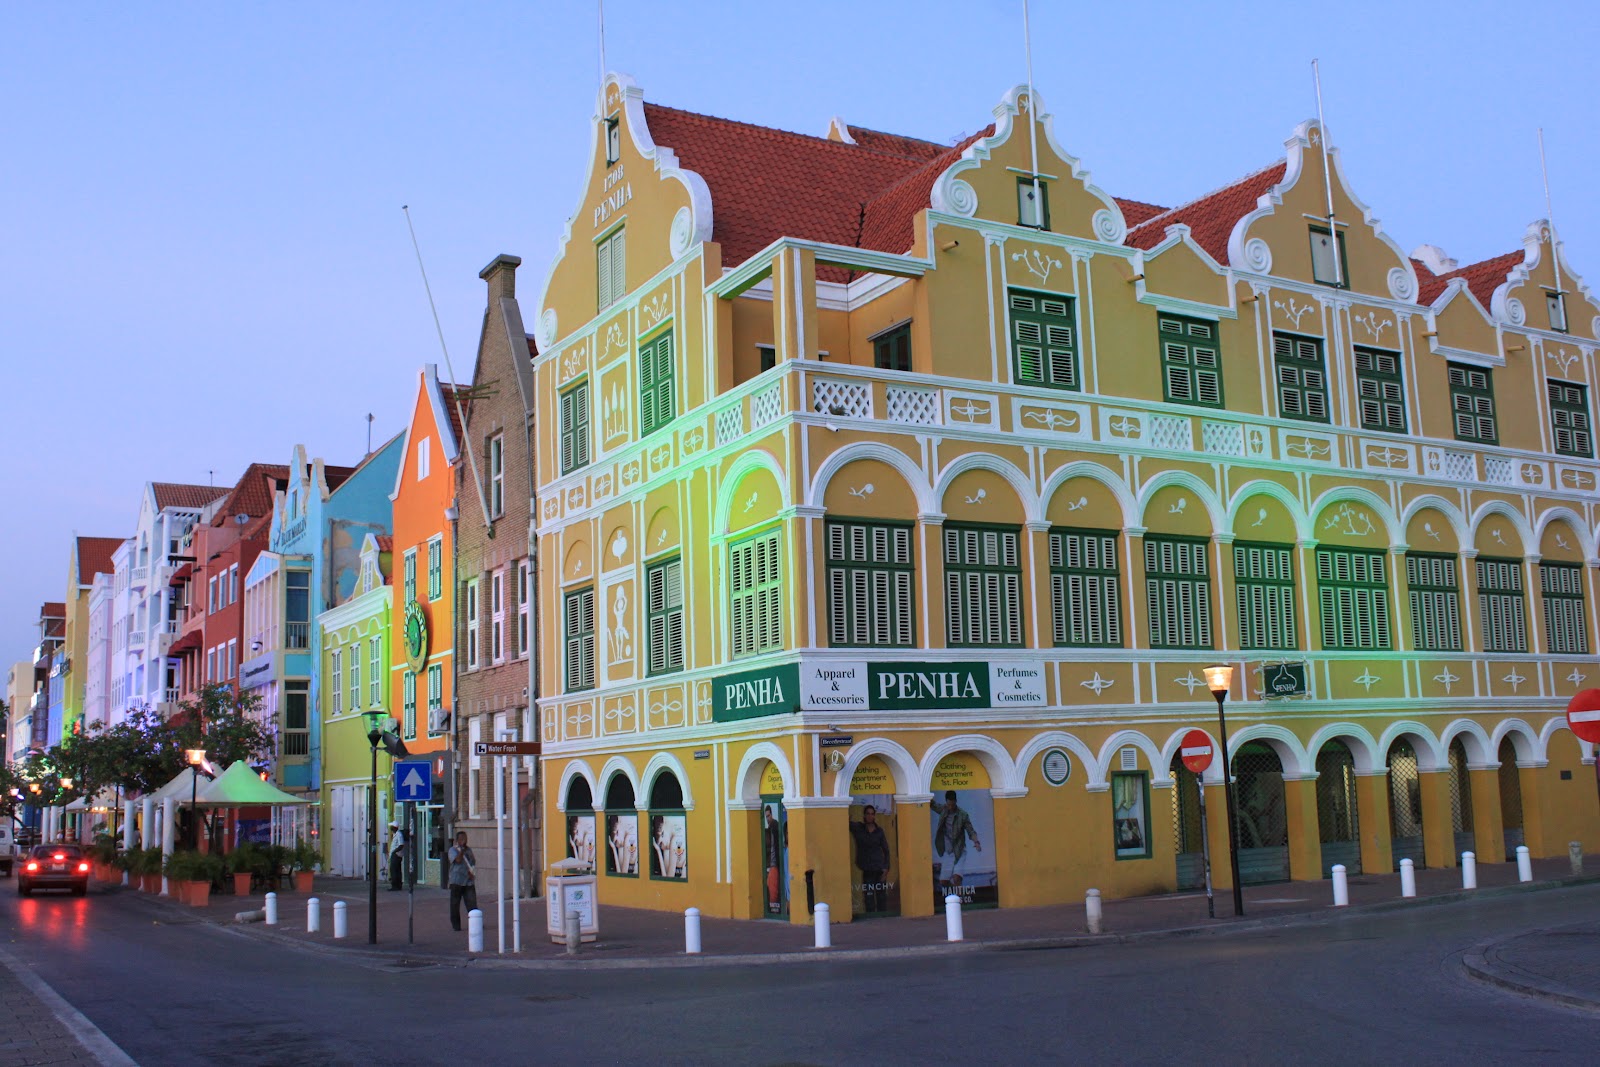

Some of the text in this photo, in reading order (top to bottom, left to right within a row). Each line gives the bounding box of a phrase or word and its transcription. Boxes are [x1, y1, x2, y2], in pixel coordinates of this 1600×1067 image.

[604, 164, 624, 193] 1708
[594, 181, 633, 228] PENHA
[815, 668, 855, 681] Apparel
[997, 667, 1038, 678] Perfumes
[831, 680, 840, 691] &
[877, 672, 981, 700] PENHA
[1014, 679, 1023, 690] &
[1276, 683, 1295, 692] PENHA
[725, 676, 785, 711] PENHA
[997, 691, 1041, 702] Cosmetics
[808, 694, 865, 705] Accessories
[488, 744, 517, 753] Water Front
[855, 766, 879, 774] lothing
[940, 762, 967, 771] Clothing
[852, 775, 887, 783] epartment
[935, 771, 973, 779] Department
[953, 778, 968, 786] Floor
[942, 885, 975, 896] NAUTICA
